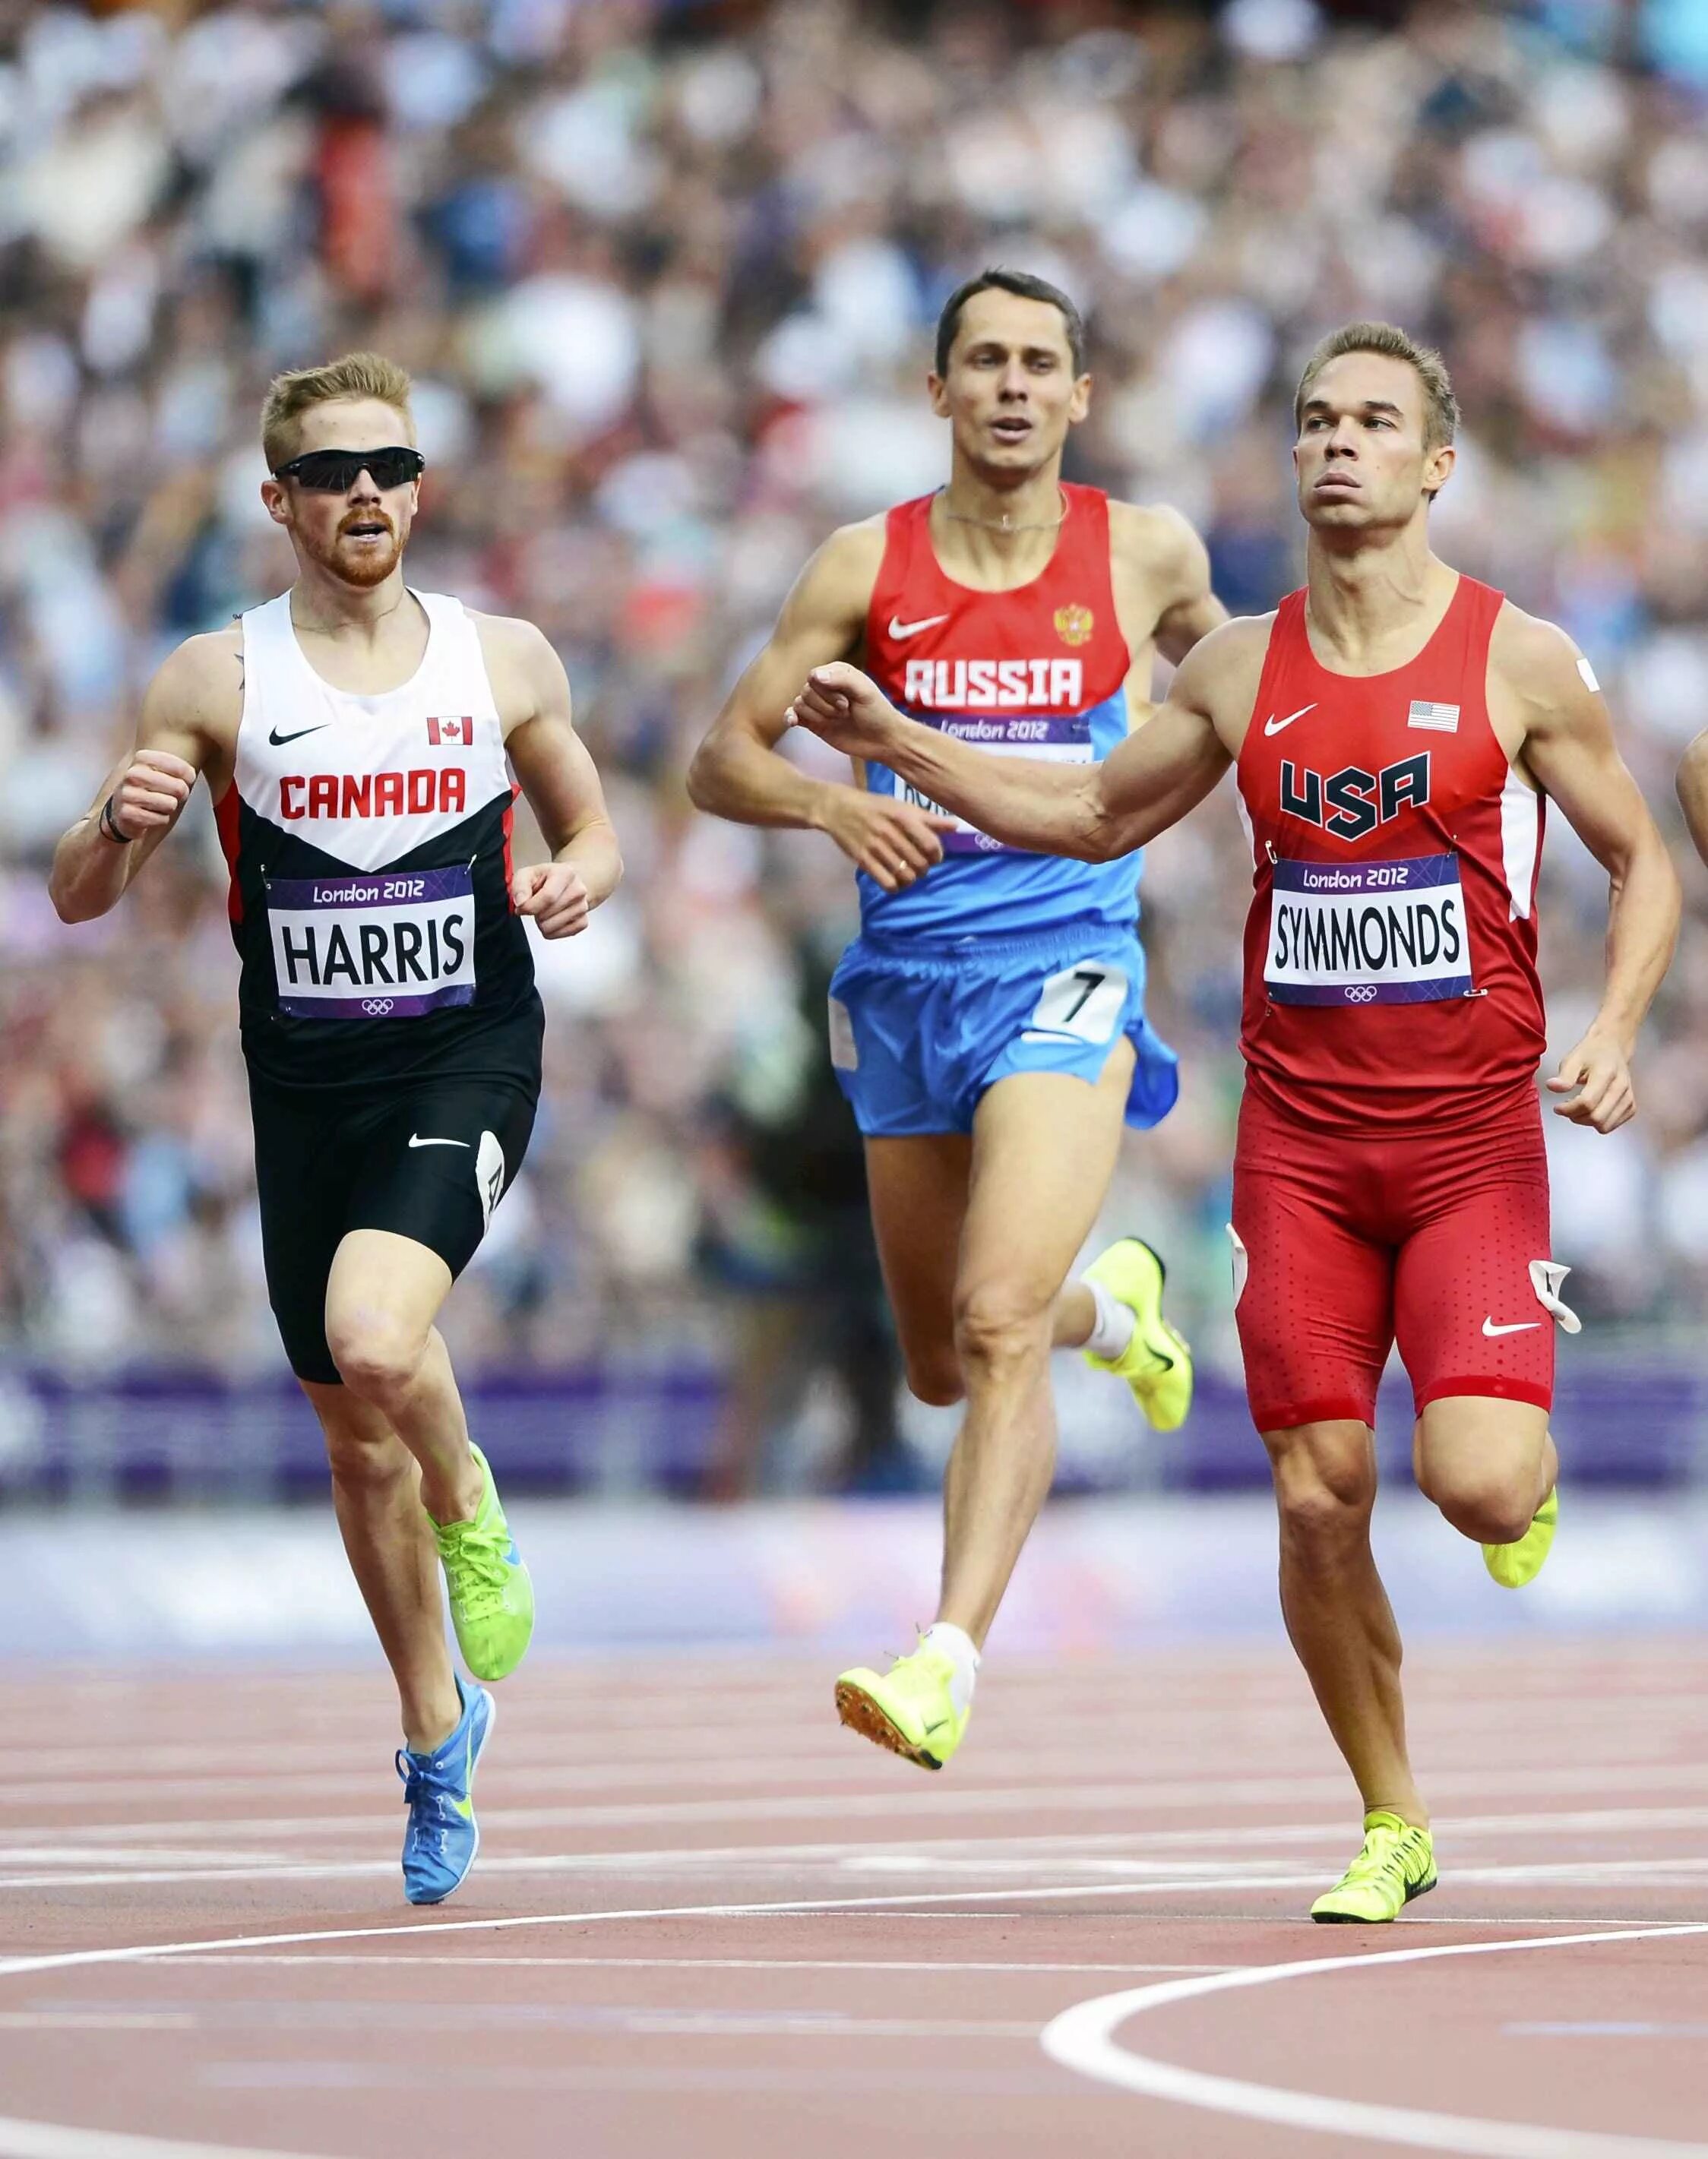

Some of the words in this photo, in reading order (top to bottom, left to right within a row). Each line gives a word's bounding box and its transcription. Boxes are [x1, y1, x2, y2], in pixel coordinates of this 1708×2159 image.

[904, 659, 1082, 707] RUSSIA
[941, 719, 1004, 739] London
[1007, 719, 1049, 741] 2012
[279, 767, 466, 820] CANADA
[1279, 751, 1431, 842] USA
[313, 881, 379, 904] London
[383, 879, 425, 899] 2012
[1303, 868, 1362, 888] London
[1366, 867, 1409, 887] 2012
[282, 914, 465, 985] HARRIS
[1274, 899, 1460, 972] SYMMONDS
[1063, 971, 1106, 1023] 7
